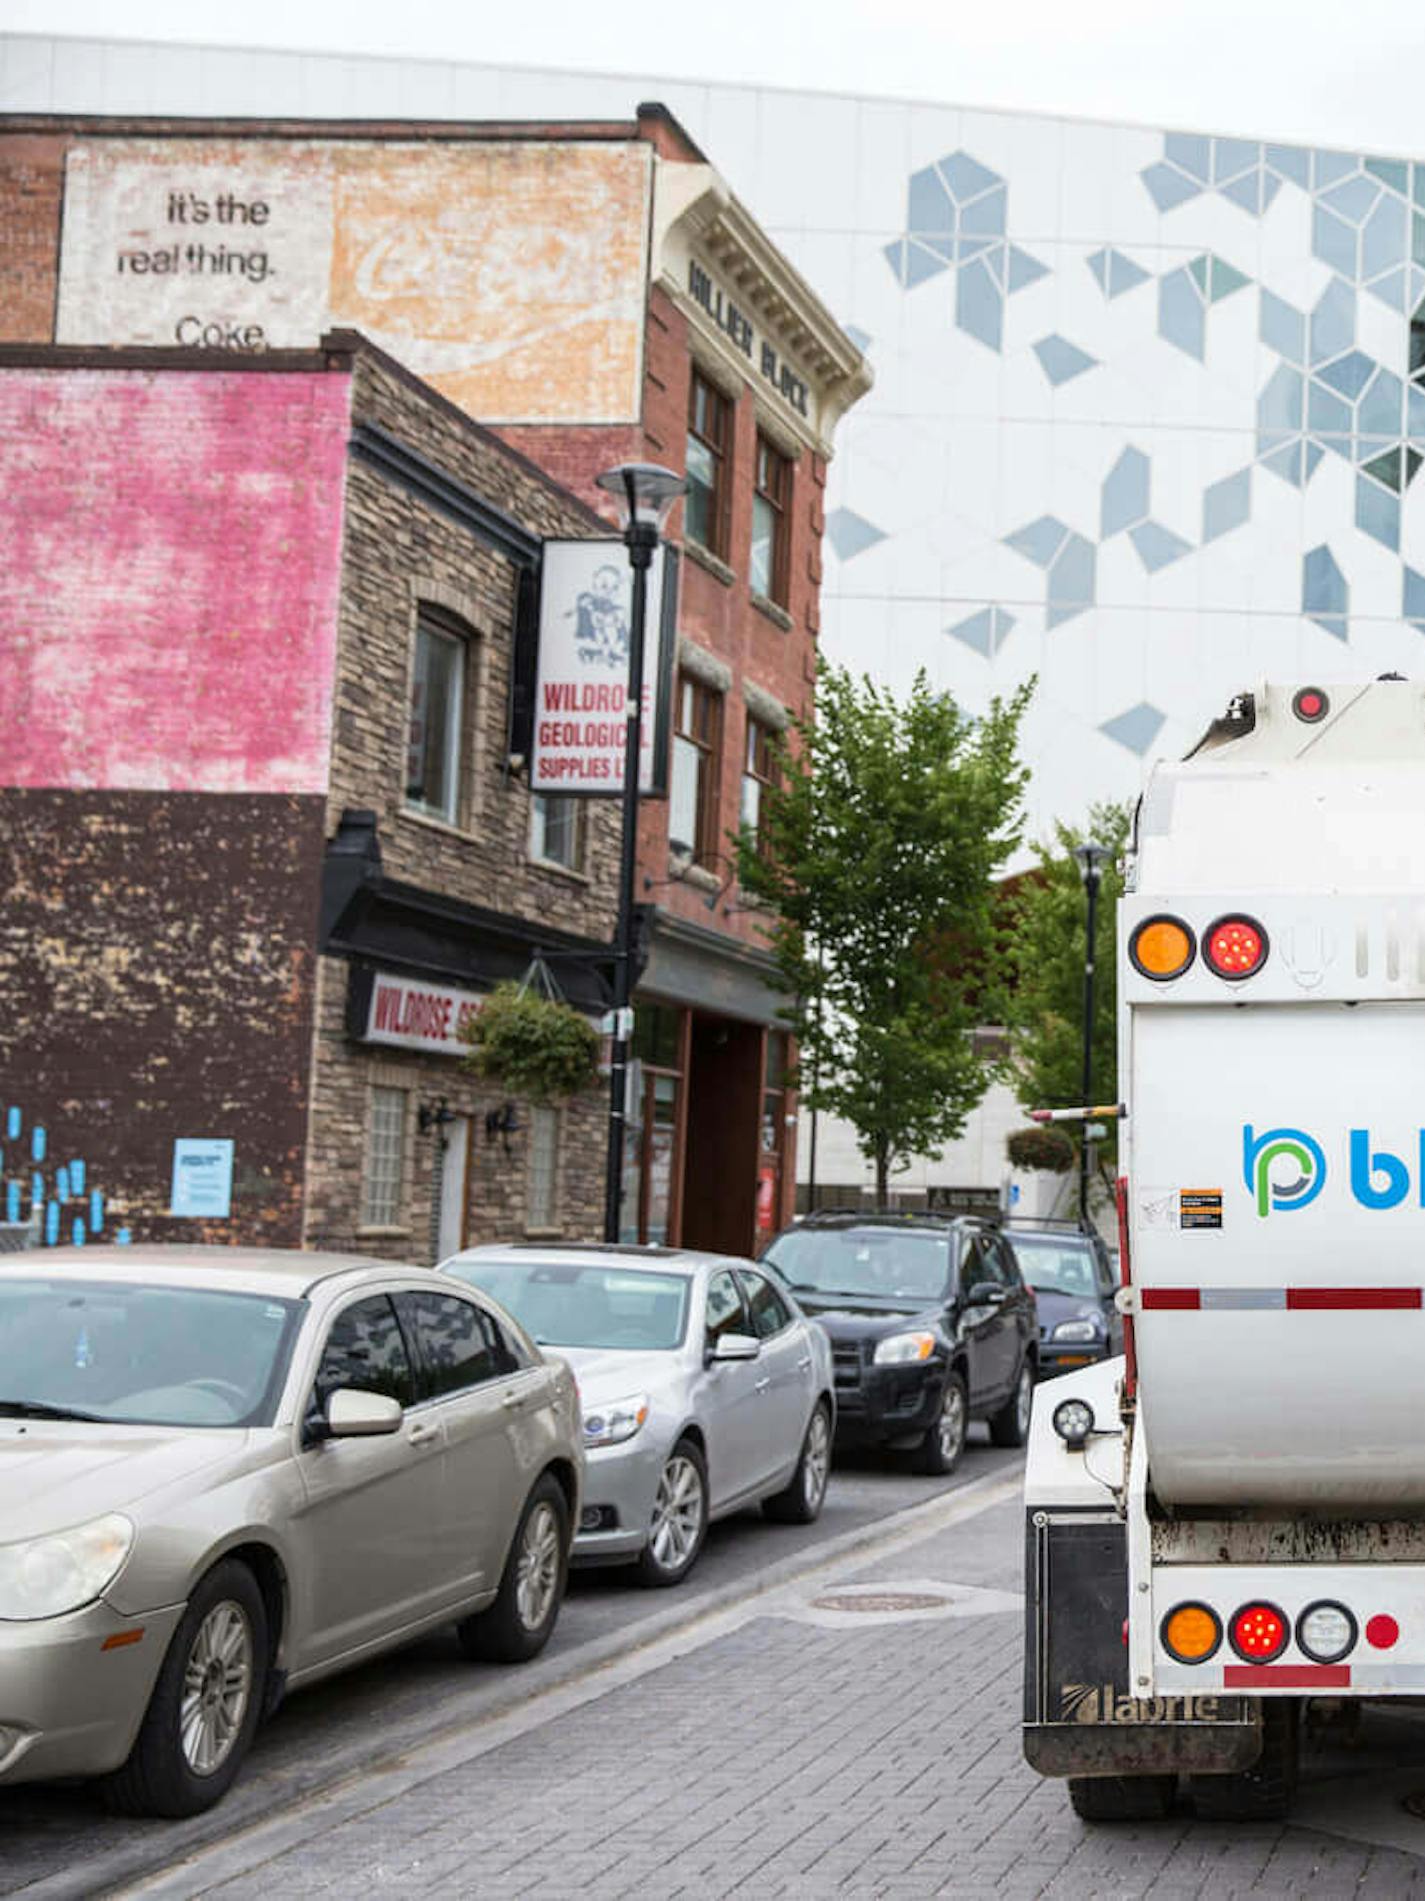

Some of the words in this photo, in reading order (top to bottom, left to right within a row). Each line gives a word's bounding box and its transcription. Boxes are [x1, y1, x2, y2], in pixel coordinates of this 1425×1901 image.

[168, 192, 210, 224] It's
[215, 192, 270, 225] the
[117, 244, 180, 275] real
[761, 341, 809, 417] BLOCK
[544, 683, 651, 713] WILDROE
[539, 720, 650, 748] GEOLOGICL
[538, 757, 611, 779] SUPPLIES
[375, 985, 452, 1041] WILDROSE
